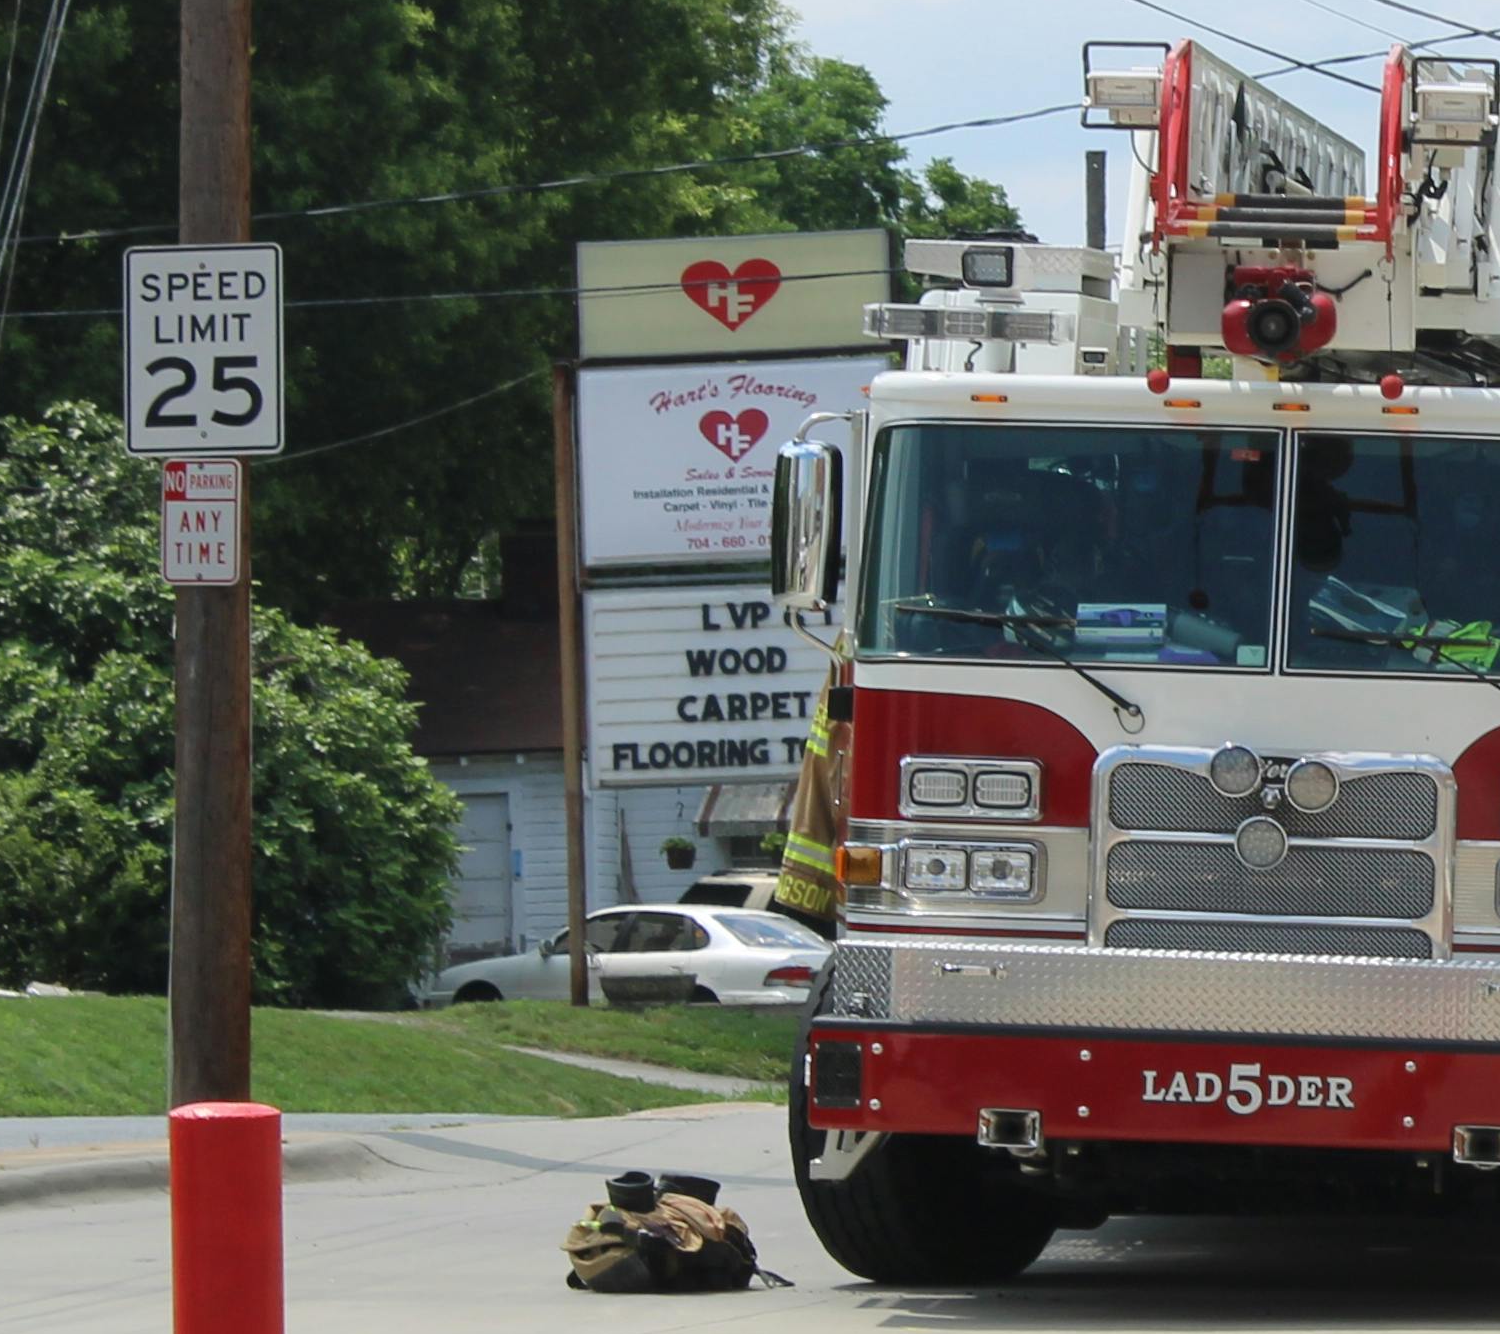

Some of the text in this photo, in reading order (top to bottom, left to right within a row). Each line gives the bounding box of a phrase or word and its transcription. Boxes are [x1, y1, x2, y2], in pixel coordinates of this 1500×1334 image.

[140, 271, 266, 302] SPEED
[154, 314, 252, 344] LIMIT
[145, 355, 263, 428] 25
[649, 374, 818, 415] Hart's Flooring
[165, 470, 233, 493] NO PARKING
[685, 468, 719, 482] Sales
[725, 466, 735, 479] &
[633, 484, 769, 499] Installation Residential &
[664, 501, 700, 513] Carpet
[710, 499, 737, 512] Vinyl
[748, 498, 767, 508] Tile
[180, 511, 221, 533] ANY
[674, 518, 734, 532] Modernize
[176, 542, 226, 565] TIME
[686, 536, 709, 549] 704
[686, 646, 787, 677] WOOD
[677, 691, 811, 723] CARPET
[612, 738, 770, 771] FLOORING
